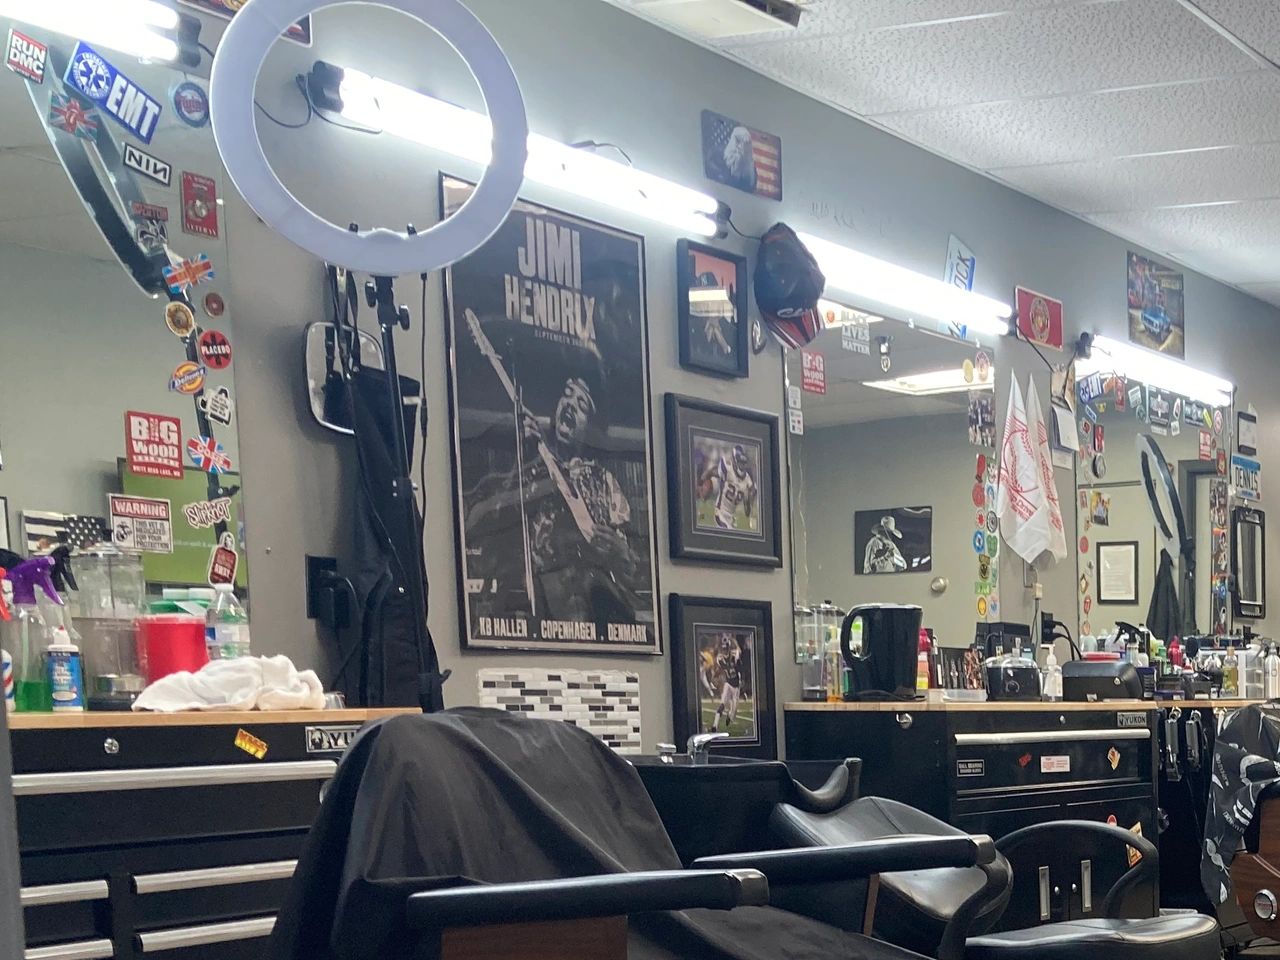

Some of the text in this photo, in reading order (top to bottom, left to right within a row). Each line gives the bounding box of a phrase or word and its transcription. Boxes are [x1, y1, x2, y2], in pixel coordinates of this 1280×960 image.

[9, 47, 45, 75] DMC
[11, 33, 47, 64] RUN
[105, 73, 161, 138] EMT
[518, 216, 581, 290] JIMI
[504, 273, 596, 341] HENDRIX
[841, 322, 870, 341] LIVES
[200, 345, 231, 355] PLACEBO
[841, 340, 871, 356] MATTER
[130, 415, 180, 446] BIG
[131, 439, 179, 459] WOOD
[1235, 466, 1259, 491] DENNIS
[115, 500, 166, 517] WARNING
[479, 617, 648, 643] KB HALLEN COPENHAGEN DENMARK
[1124, 715, 1146, 726] YUKON
